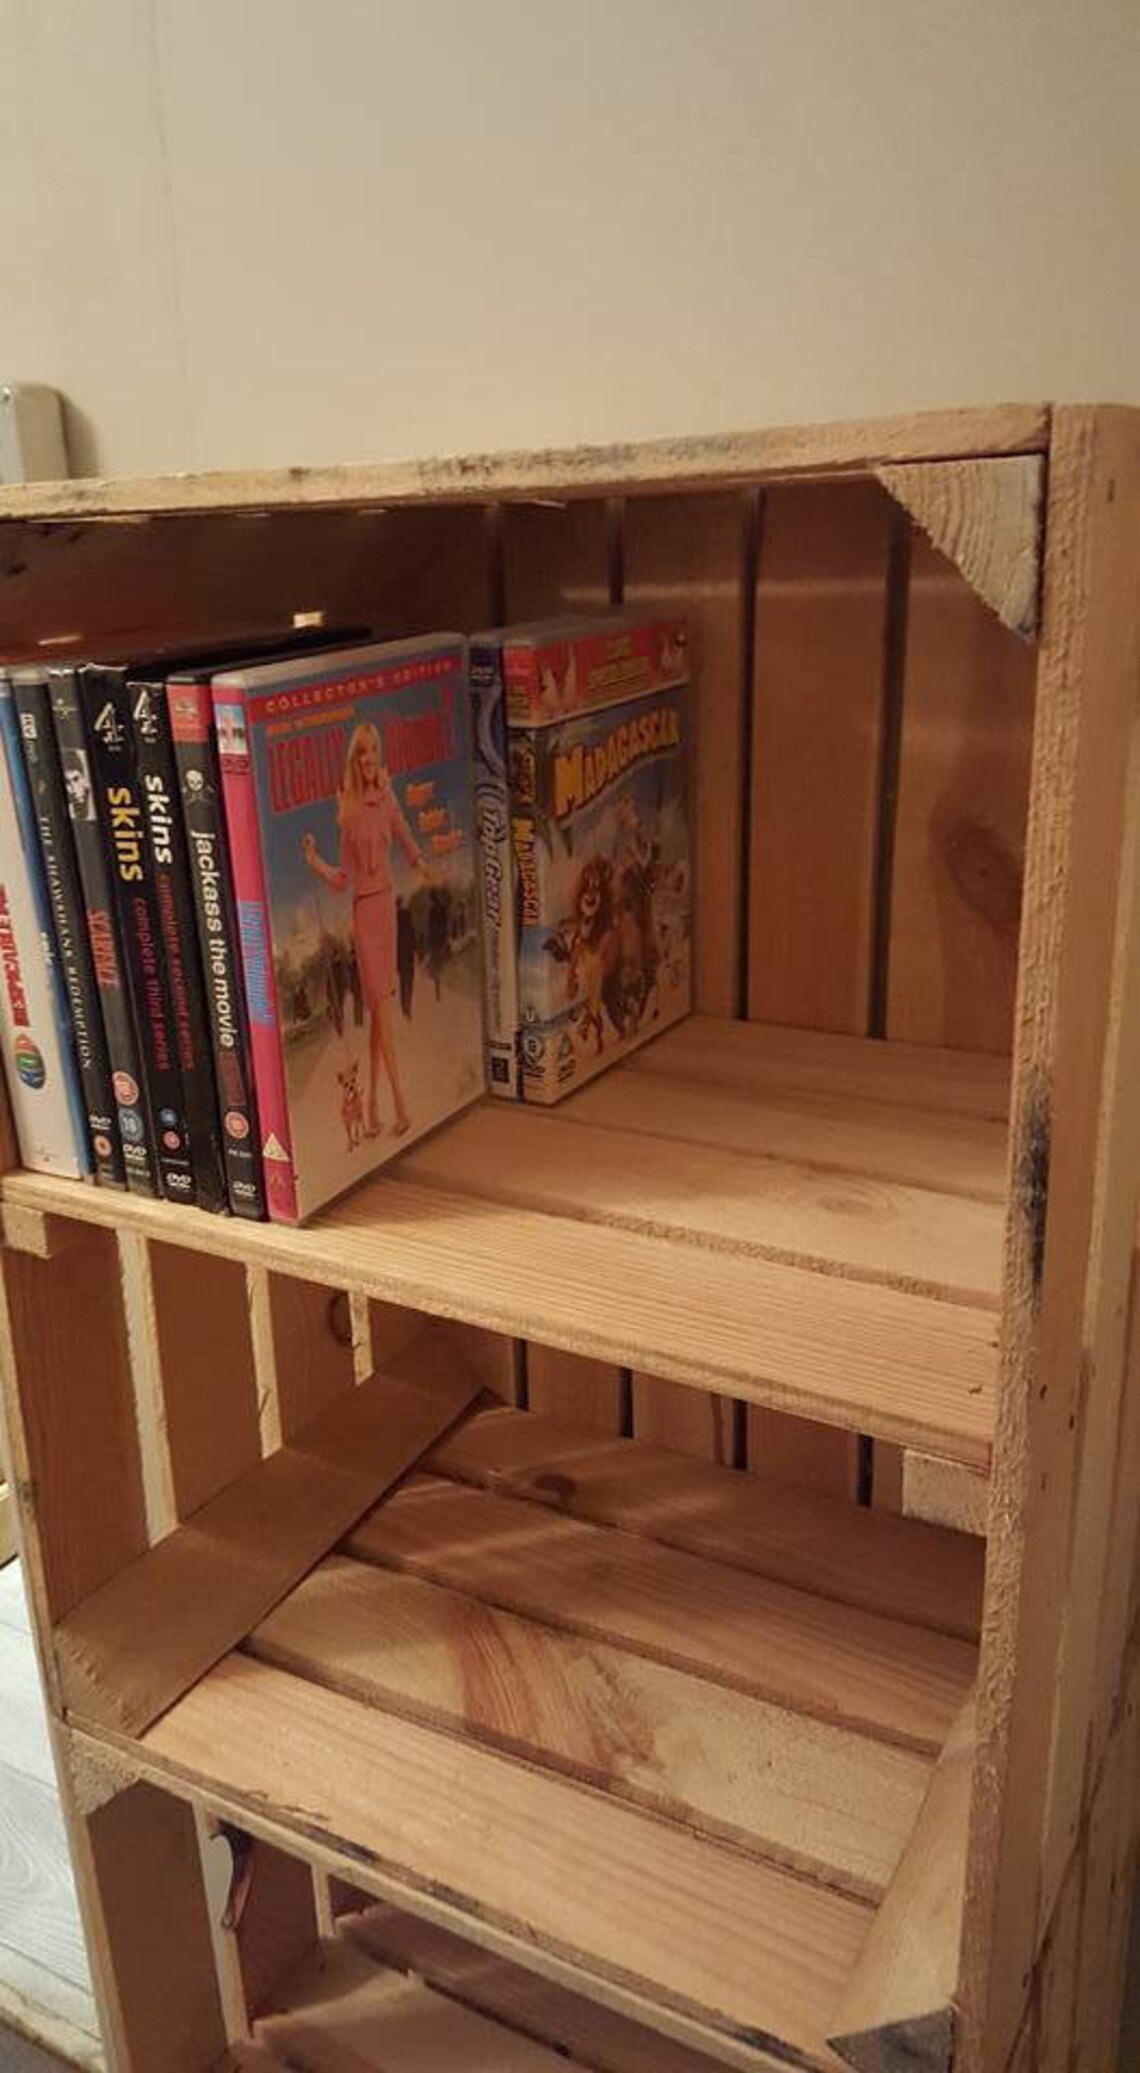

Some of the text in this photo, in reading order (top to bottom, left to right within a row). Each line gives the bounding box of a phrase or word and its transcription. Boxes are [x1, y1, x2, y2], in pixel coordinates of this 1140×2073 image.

[552, 706, 682, 819] MADAGASCAR
[107, 787, 145, 882] skins
[145, 774, 174, 864] skins
[190, 830, 224, 933] jackass
[134, 897, 157, 975] complete
[208, 937, 228, 976] the
[67, 965, 94, 1071] REDEMPTION
[145, 978, 166, 1019] third
[212, 977, 239, 1048] movie
